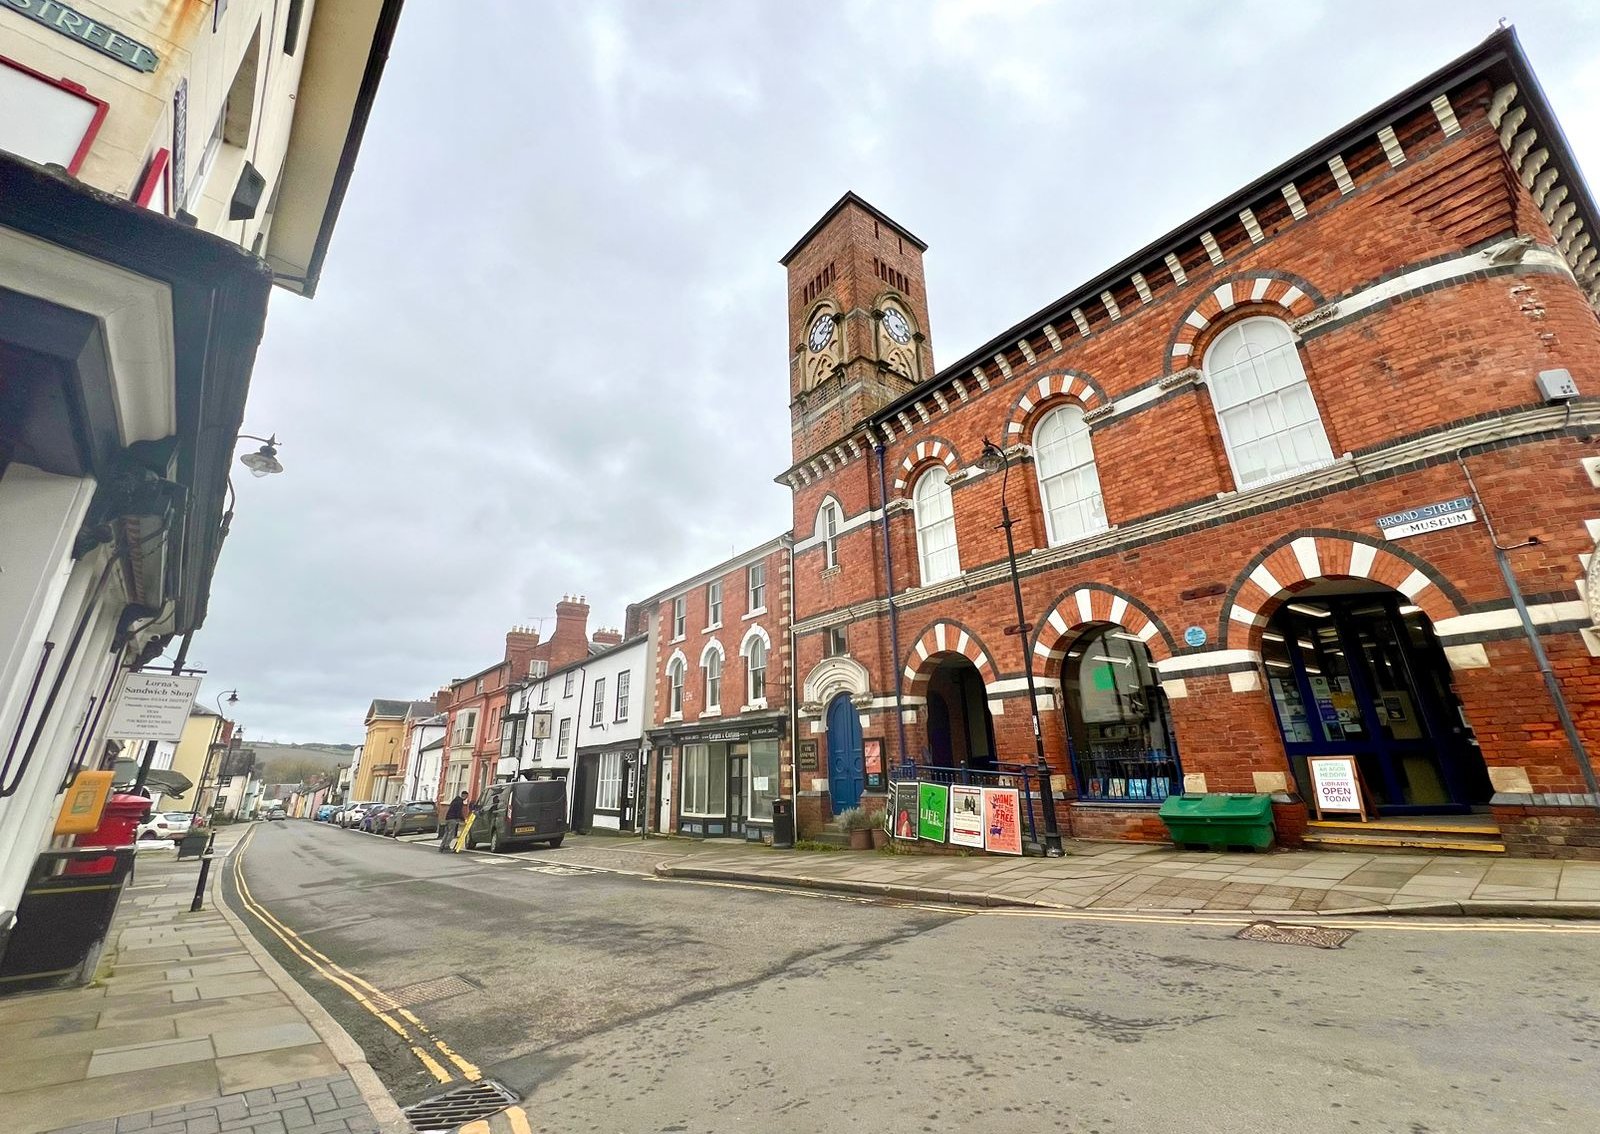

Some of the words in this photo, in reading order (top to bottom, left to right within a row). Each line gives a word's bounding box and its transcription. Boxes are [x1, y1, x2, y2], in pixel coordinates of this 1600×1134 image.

[1378, 510, 1419, 527] BROAD
[1423, 498, 1469, 515] STREET
[1410, 513, 1468, 532] MUSEUM
[145, 680, 179, 688] Lorna's
[124, 687, 168, 695] Sandwich
[170, 690, 193, 698] Shop
[1322, 787, 1351, 795] OPEN
[1324, 795, 1352, 803] TODAY
[996, 809, 1015, 823] FREE
